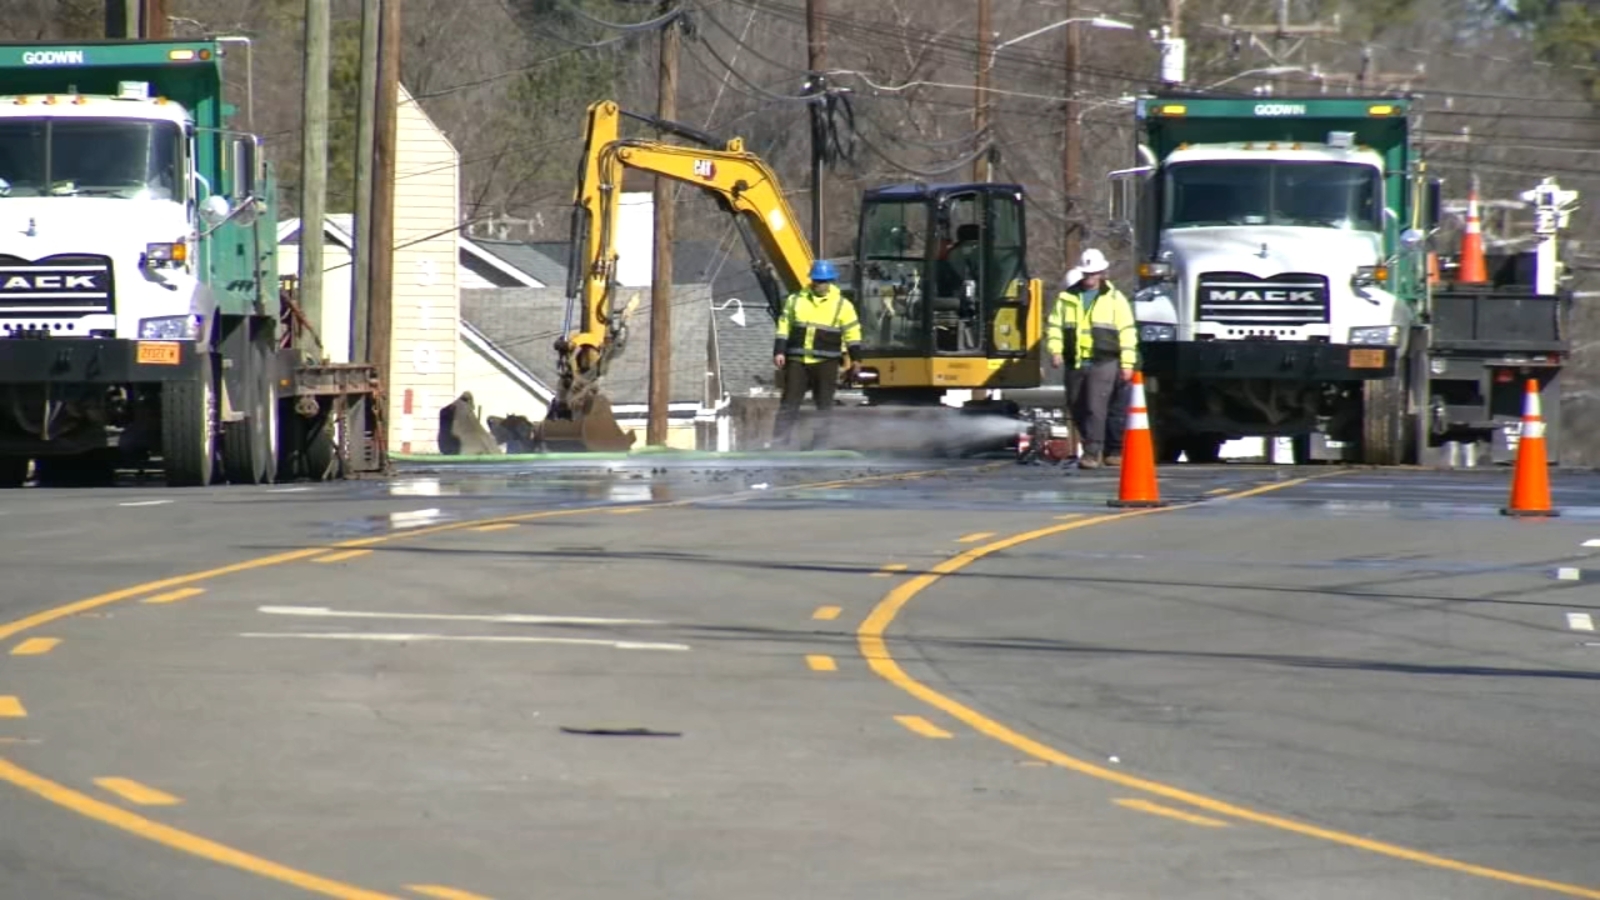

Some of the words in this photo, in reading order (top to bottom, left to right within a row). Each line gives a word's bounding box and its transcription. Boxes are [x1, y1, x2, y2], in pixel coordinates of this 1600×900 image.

[22, 50, 83, 65] GODWIN
[1254, 104, 1306, 116] GODWIN
[694, 159, 711, 176] CAT
[3, 276, 97, 289] ACK
[1209, 290, 1316, 301] MACK
